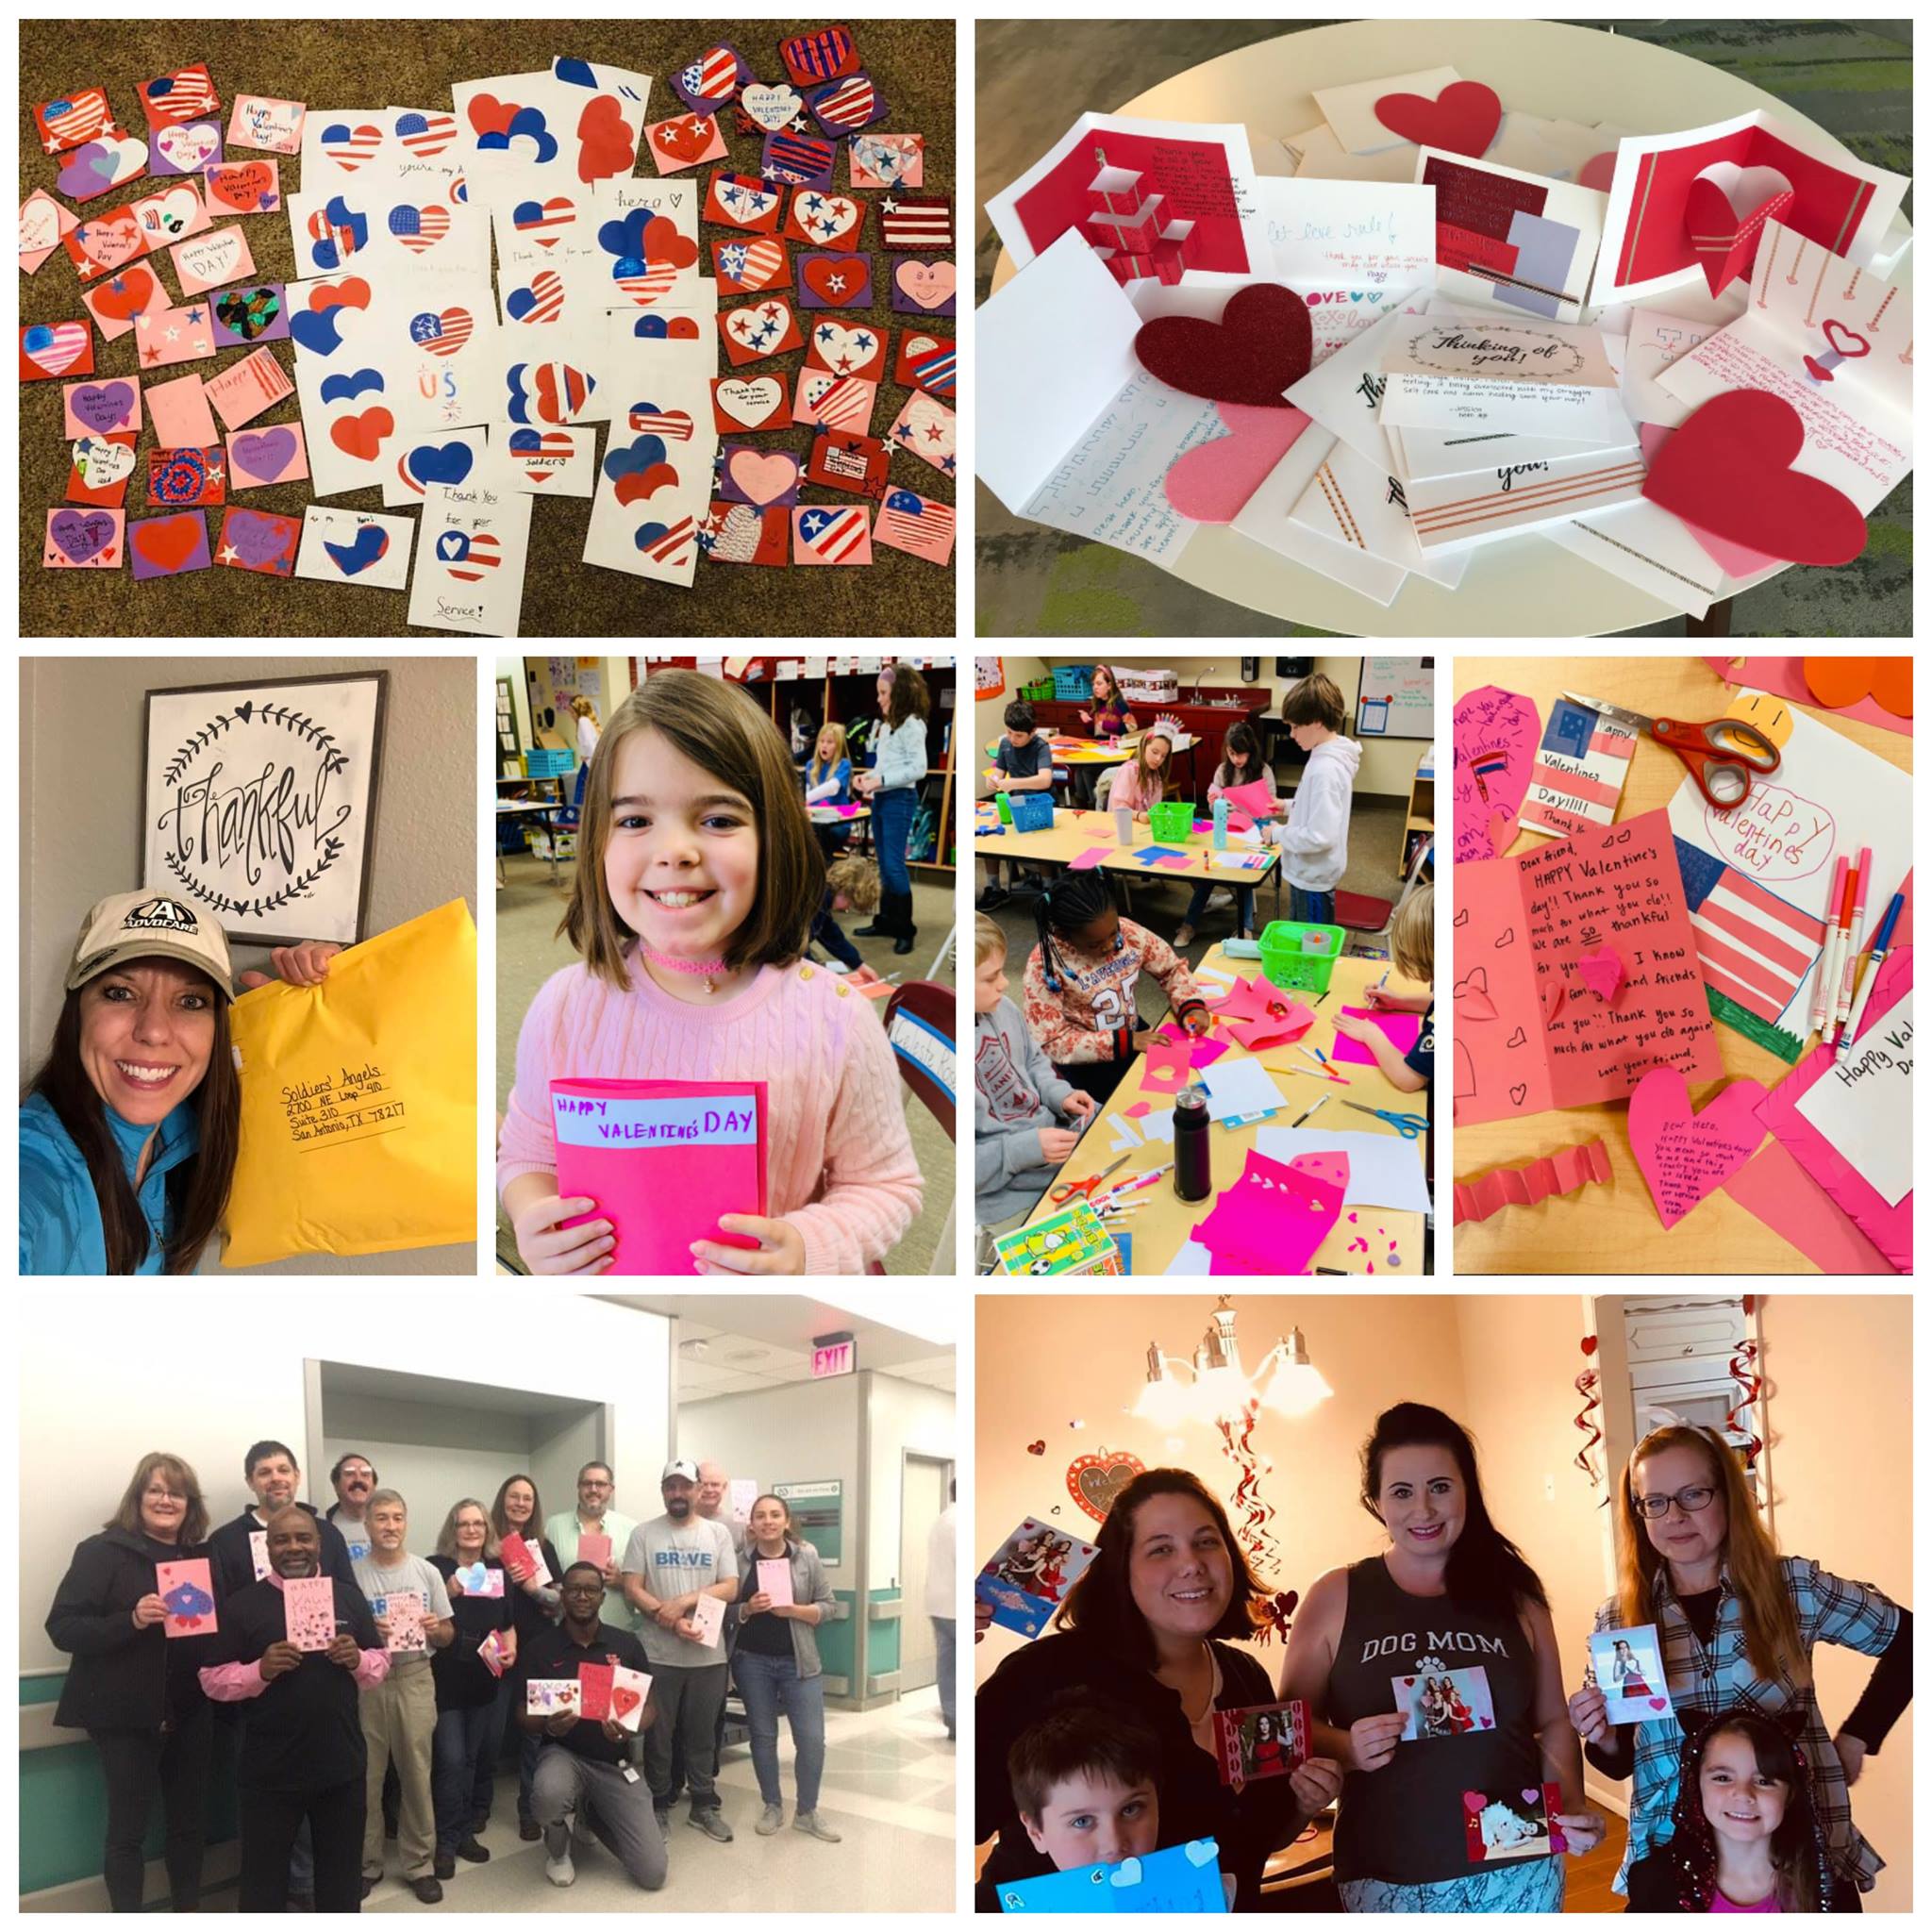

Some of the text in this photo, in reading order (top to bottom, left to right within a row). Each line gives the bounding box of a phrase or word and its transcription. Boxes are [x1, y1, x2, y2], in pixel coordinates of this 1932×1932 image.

[615, 190, 661, 208] hero
[1300, 291, 1348, 308] OVE
[1432, 334, 1560, 358] Thinking of
[1472, 352, 1528, 366] you!
[1496, 460, 1550, 491] you!
[442, 486, 477, 502] Thank
[437, 595, 485, 618] Service!
[1543, 753, 1601, 782] Valentines
[158, 758, 351, 886] thankful
[1543, 809, 1573, 833] Thank
[1520, 856, 1541, 872] Dear
[1534, 847, 1658, 889] HAPPY Valentine's
[1734, 839, 1773, 873] day
[1563, 886, 1606, 904] Thank
[1613, 880, 1641, 899] you
[121, 918, 199, 935] ADVOCARE
[1532, 922, 1555, 936] much
[1559, 919, 1574, 929] for
[1578, 907, 1611, 922] what
[1616, 899, 1641, 916] you
[1553, 936, 1572, 949] are
[1610, 910, 1671, 933] thankful
[1537, 961, 1551, 974] for
[1634, 951, 1645, 966] I
[1653, 947, 1686, 961] know
[1624, 970, 1697, 990] and friends
[1607, 1008, 1647, 1024] Thank
[1656, 1008, 1676, 1024] you
[1554, 1041, 1578, 1055] much
[1581, 1040, 1594, 1053] for
[1598, 1035, 1628, 1051] what
[1635, 1031, 1657, 1047] you
[1660, 1026, 1674, 1039] do
[1598, 1064, 1619, 1078] Love
[1624, 1058, 1650, 1075] your
[1835, 1049, 1894, 1088] Happy
[279, 1063, 382, 1105] Soldiers' Angels
[286, 1101, 312, 1117] 2700
[320, 1095, 333, 1108] NE
[338, 1091, 358, 1102] Loop
[557, 1098, 608, 1117] HAPPY
[290, 1108, 340, 1130] Suite 310
[291, 1129, 312, 1141] San
[368, 1102, 406, 1124] 78217
[598, 1109, 754, 1140] VALENTINE'S DAY
[1089, 1194, 1111, 1208] COOL
[814, 1344, 850, 1376] EXIT
[1360, 1630, 1510, 1664] DOG MOM
